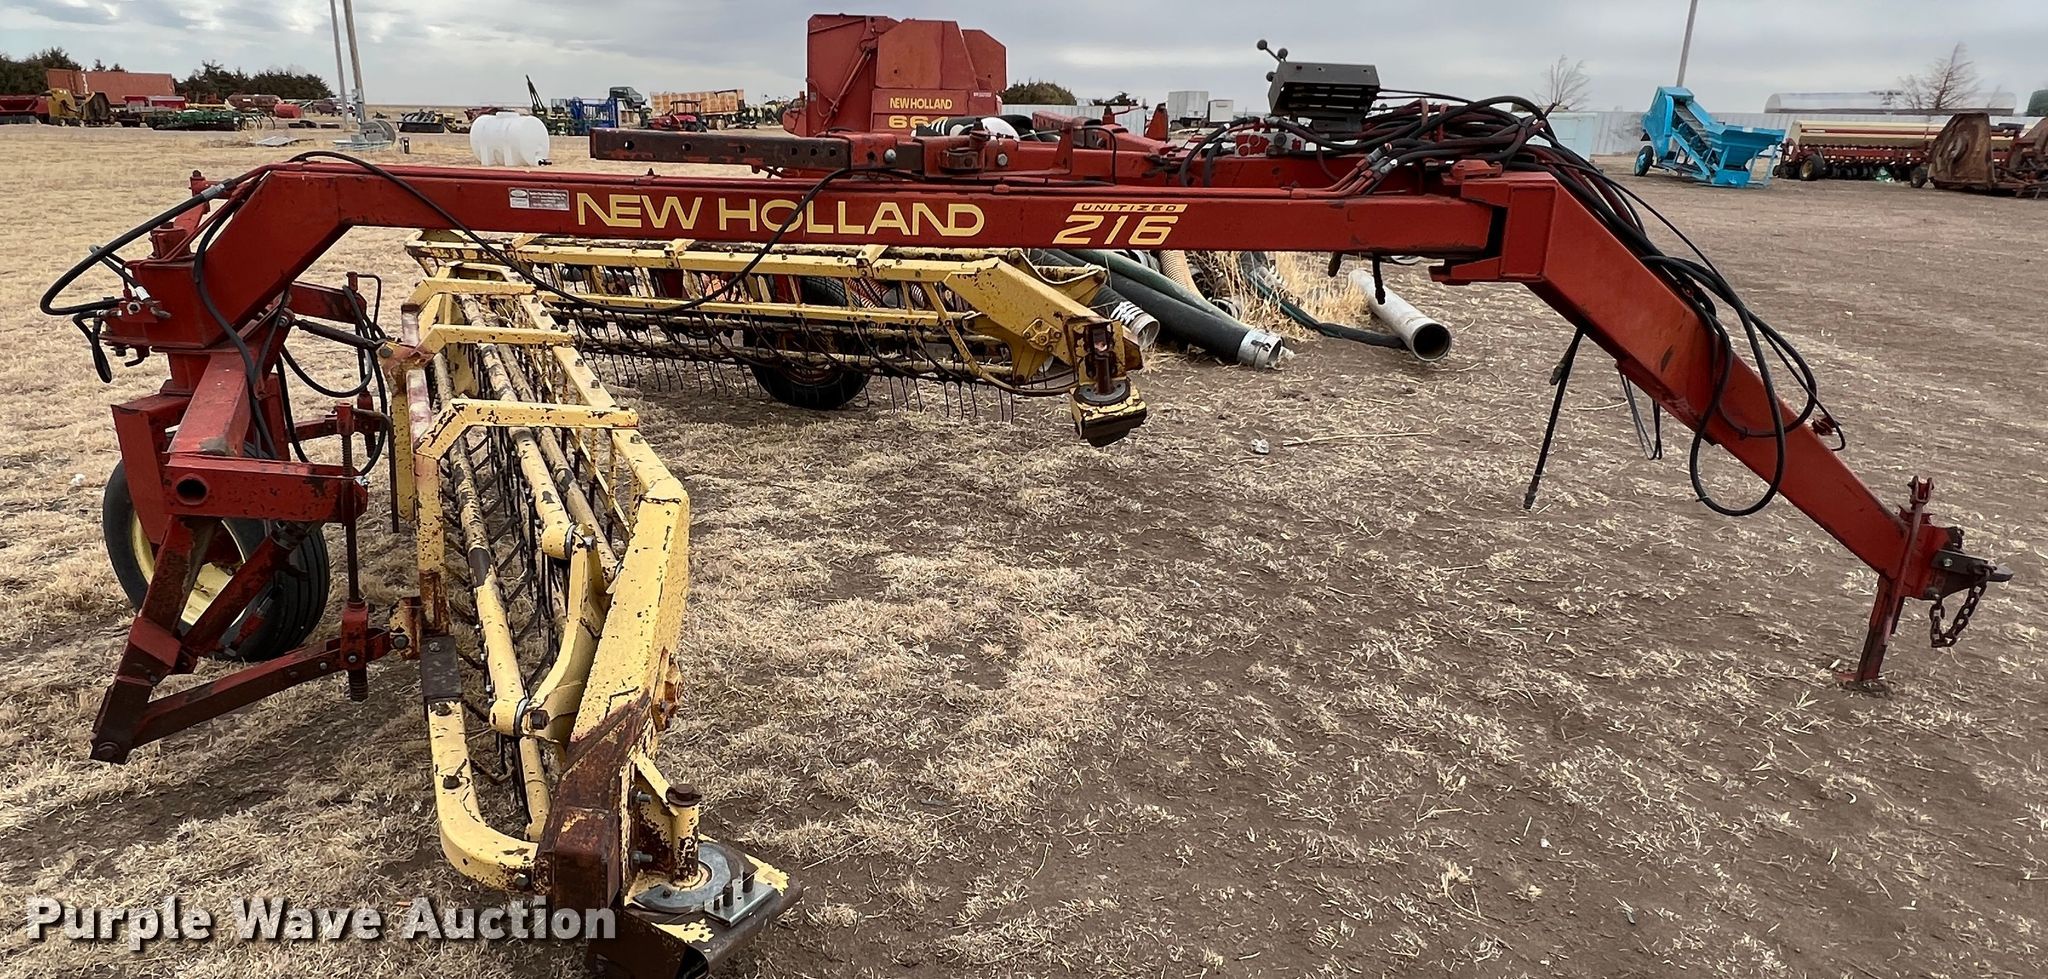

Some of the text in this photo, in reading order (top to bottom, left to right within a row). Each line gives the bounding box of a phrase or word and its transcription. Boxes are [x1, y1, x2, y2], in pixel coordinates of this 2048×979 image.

[890, 97, 953, 110] NEW HOLLAND
[577, 192, 703, 230] NEW
[719, 197, 985, 237] HOLLAND
[1081, 204, 1177, 212] UNITIZED
[1052, 214, 1179, 245] 216
